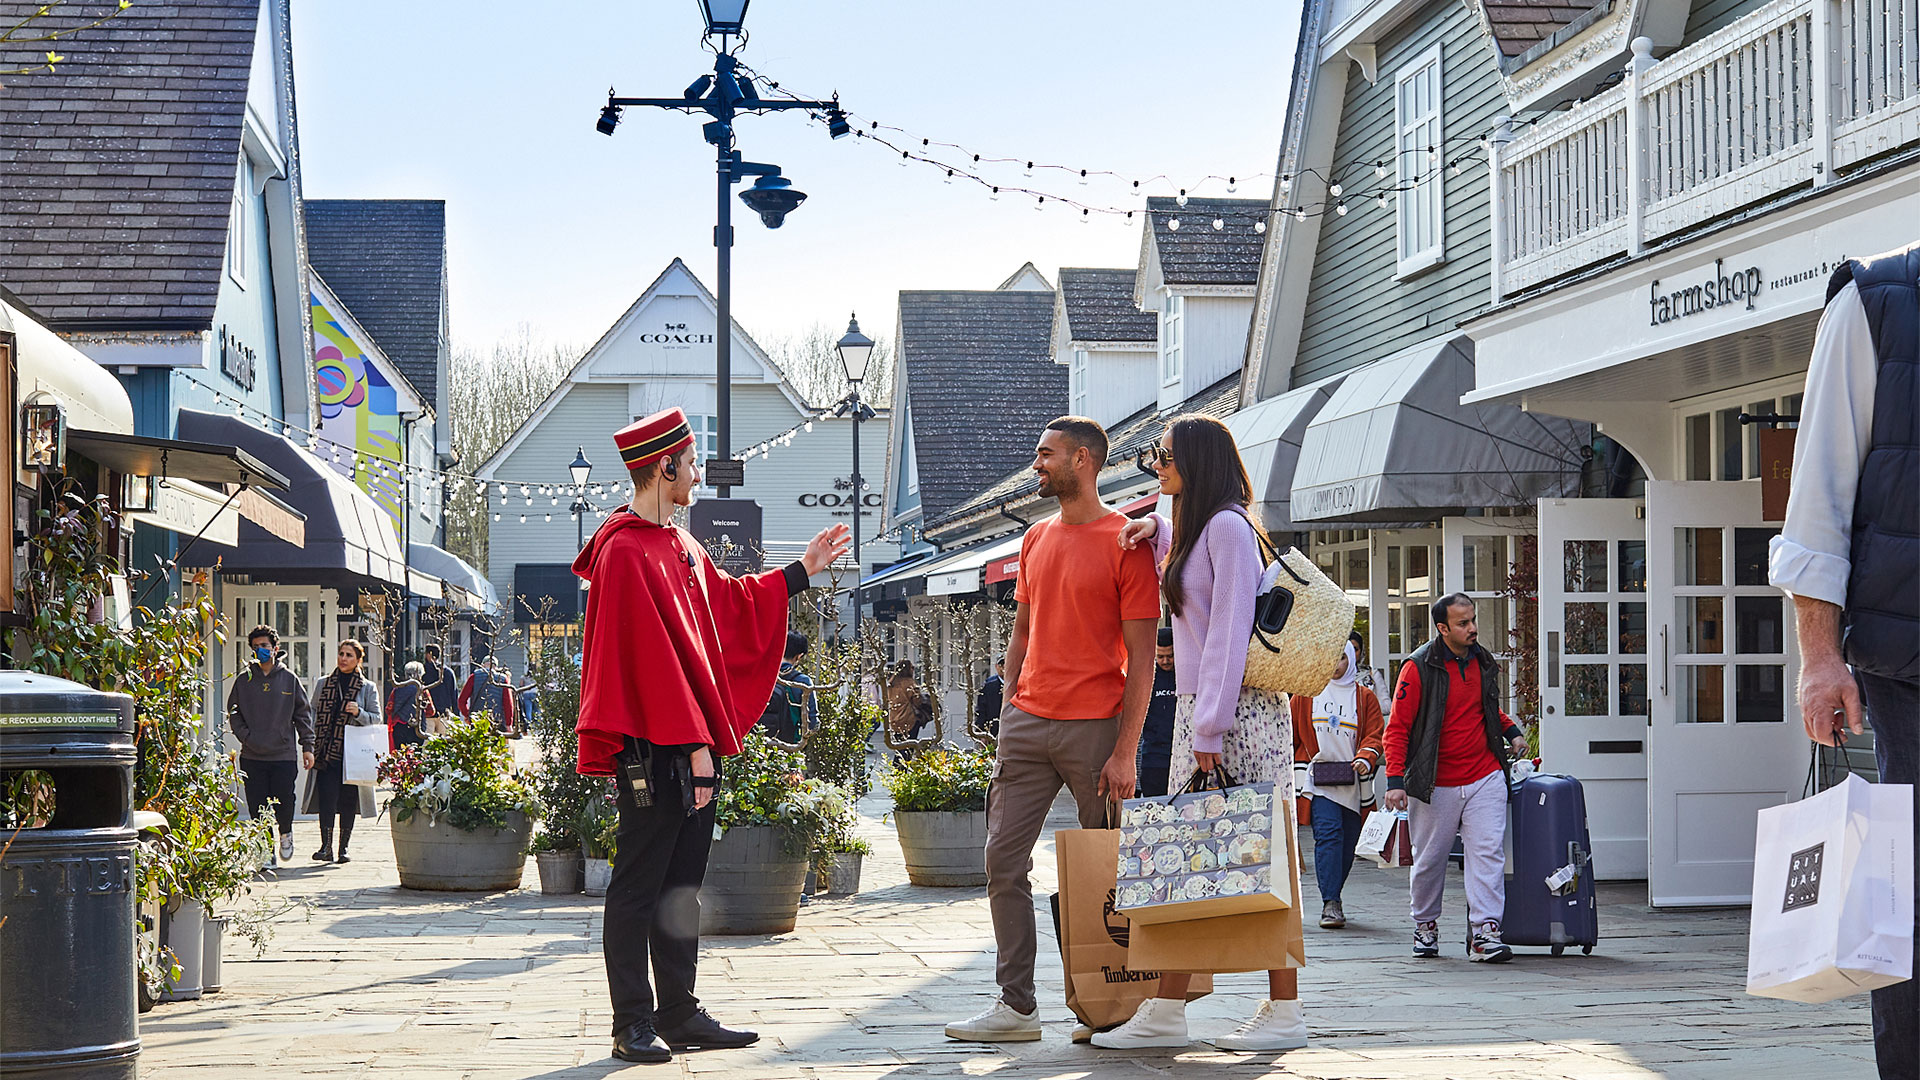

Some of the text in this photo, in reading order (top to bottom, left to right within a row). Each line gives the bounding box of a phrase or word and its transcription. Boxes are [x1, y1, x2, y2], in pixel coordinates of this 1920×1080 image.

[1770, 265, 1819, 290] restaurant
[1822, 261, 1828, 274] &
[1650, 257, 1763, 326] farmshop
[640, 334, 713, 343] COACH
[1772, 459, 1791, 479] fa
[798, 493, 882, 508] COAC
[1333, 484, 1355, 509] CHOO
[712, 519, 740, 527] Welcome
[421, 612, 449, 621] BOSS
[1396, 681, 1410, 700] 3
[9, 716, 51, 725] RECYCLING
[52, 716, 63, 724] SO
[64, 716, 77, 724] YOU
[79, 716, 96, 724] DON'T
[96, 716, 109, 724] HAVE
